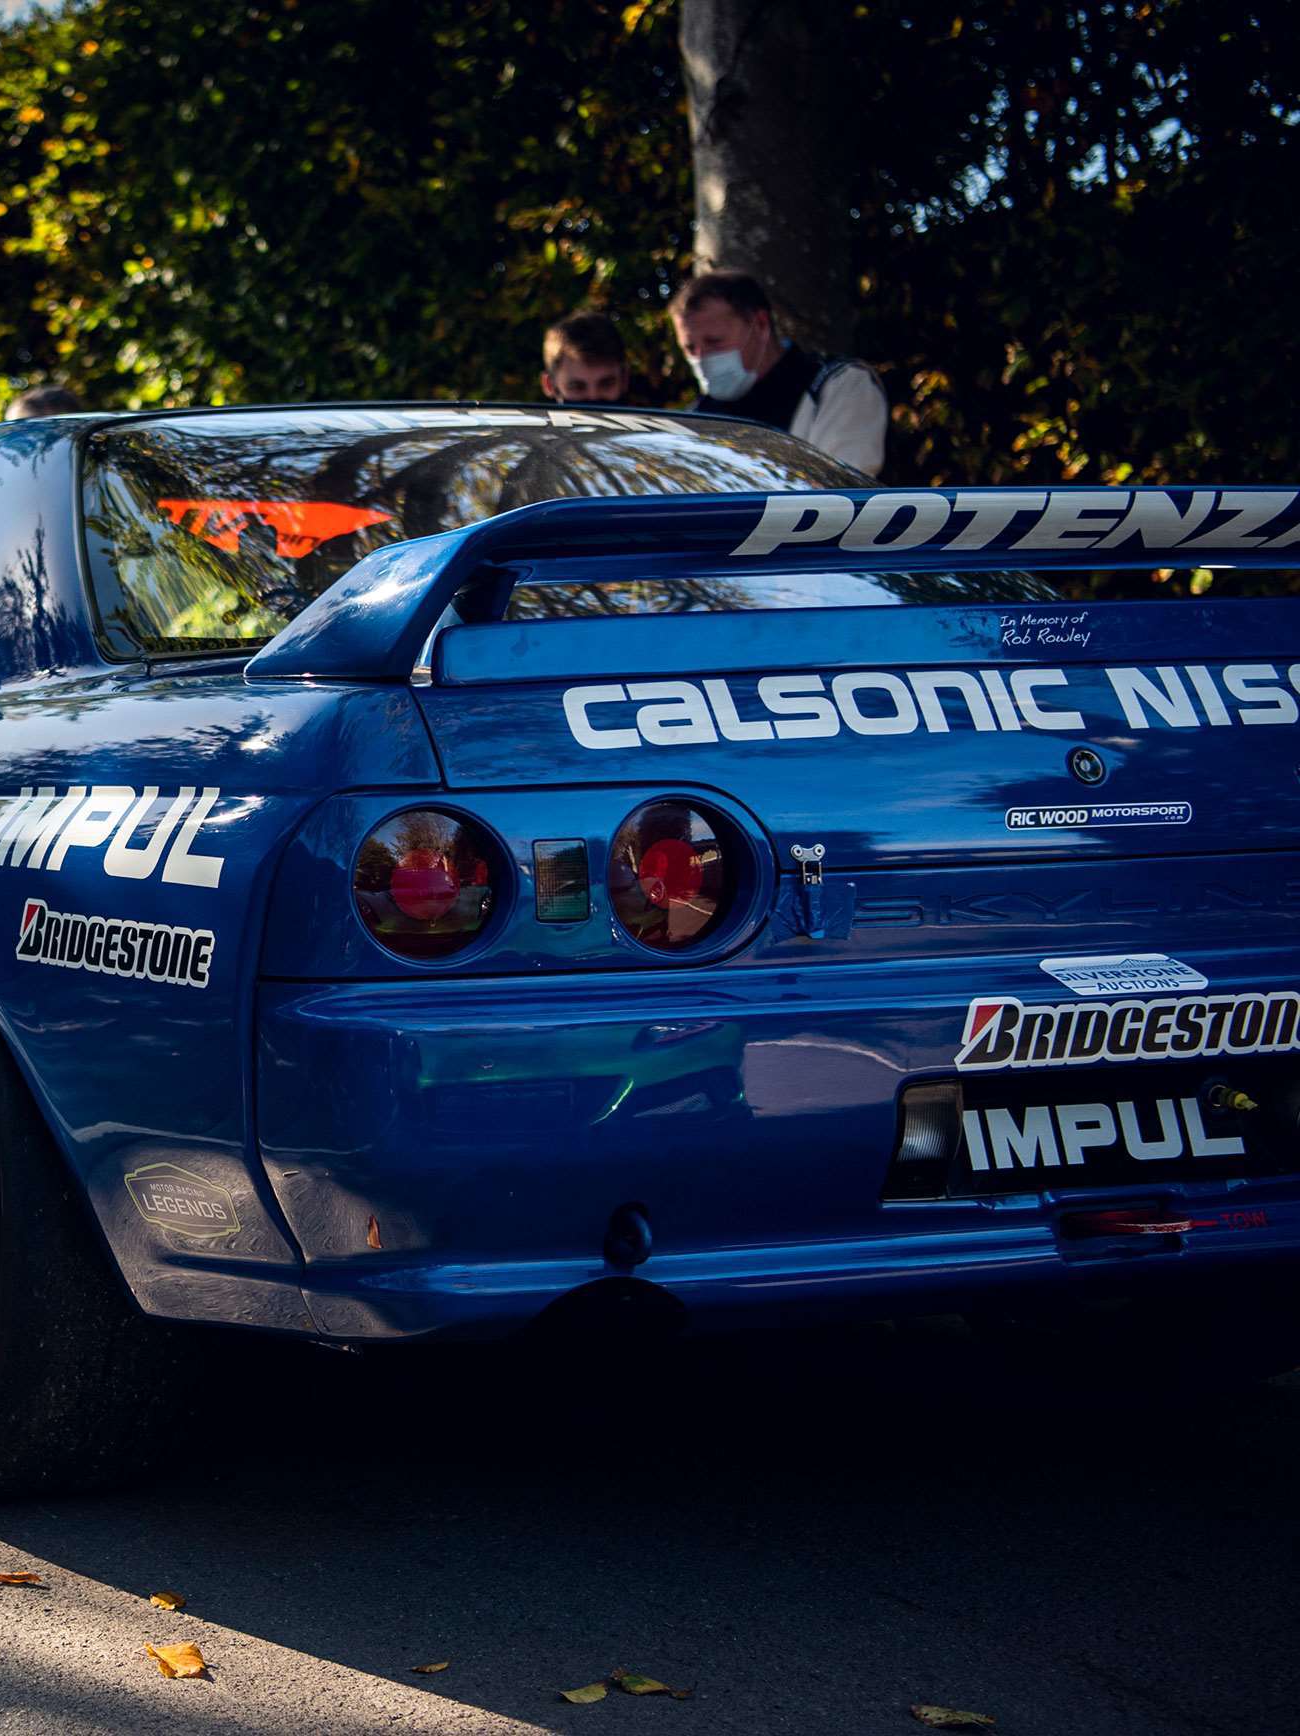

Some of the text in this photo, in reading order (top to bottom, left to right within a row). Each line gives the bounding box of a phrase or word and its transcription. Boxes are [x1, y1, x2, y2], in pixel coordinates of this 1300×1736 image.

[290, 409, 699, 435] NISSAN
[1000, 611, 1089, 628] In Memory of
[1002, 628, 1091, 647] Rob Rowley
[1010, 806, 1187, 826] RIC WOOD MOTORSPORT
[17, 901, 214, 985] BRIDGESTONE
[1055, 966, 1193, 982] SILVERSTONE
[1097, 978, 1180, 992] AUCTIONS
[957, 995, 1300, 1067] BRIDGESTON
[963, 1097, 1245, 1171] IMPUL
[149, 1183, 206, 1198] MOTOR RACING
[142, 1193, 228, 1220] LEGENDS
